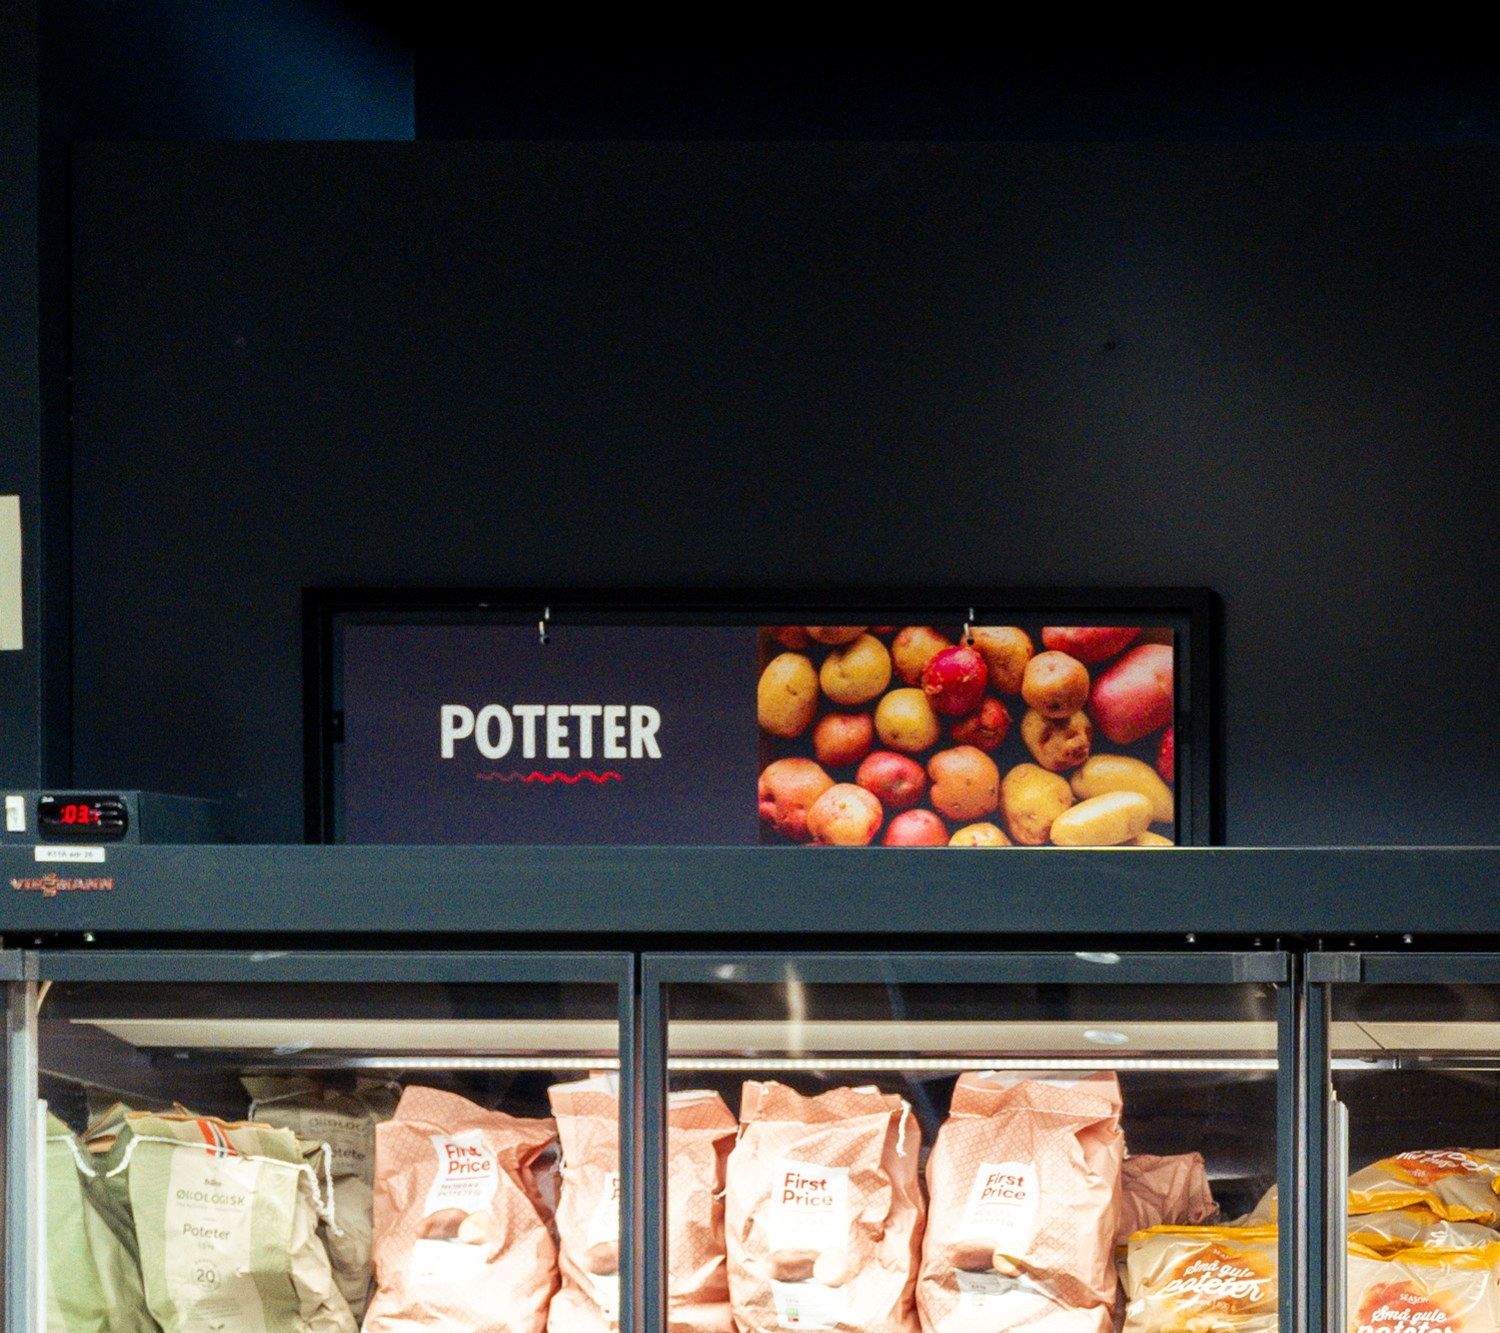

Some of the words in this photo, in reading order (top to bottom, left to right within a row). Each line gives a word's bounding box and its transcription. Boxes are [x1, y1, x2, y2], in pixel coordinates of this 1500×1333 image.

[440, 703, 663, 762] POTETER
[783, 1171, 826, 1193] First
[985, 1171, 1026, 1190] First
[782, 1188, 833, 1208] Price
[981, 1186, 1026, 1204] Price
